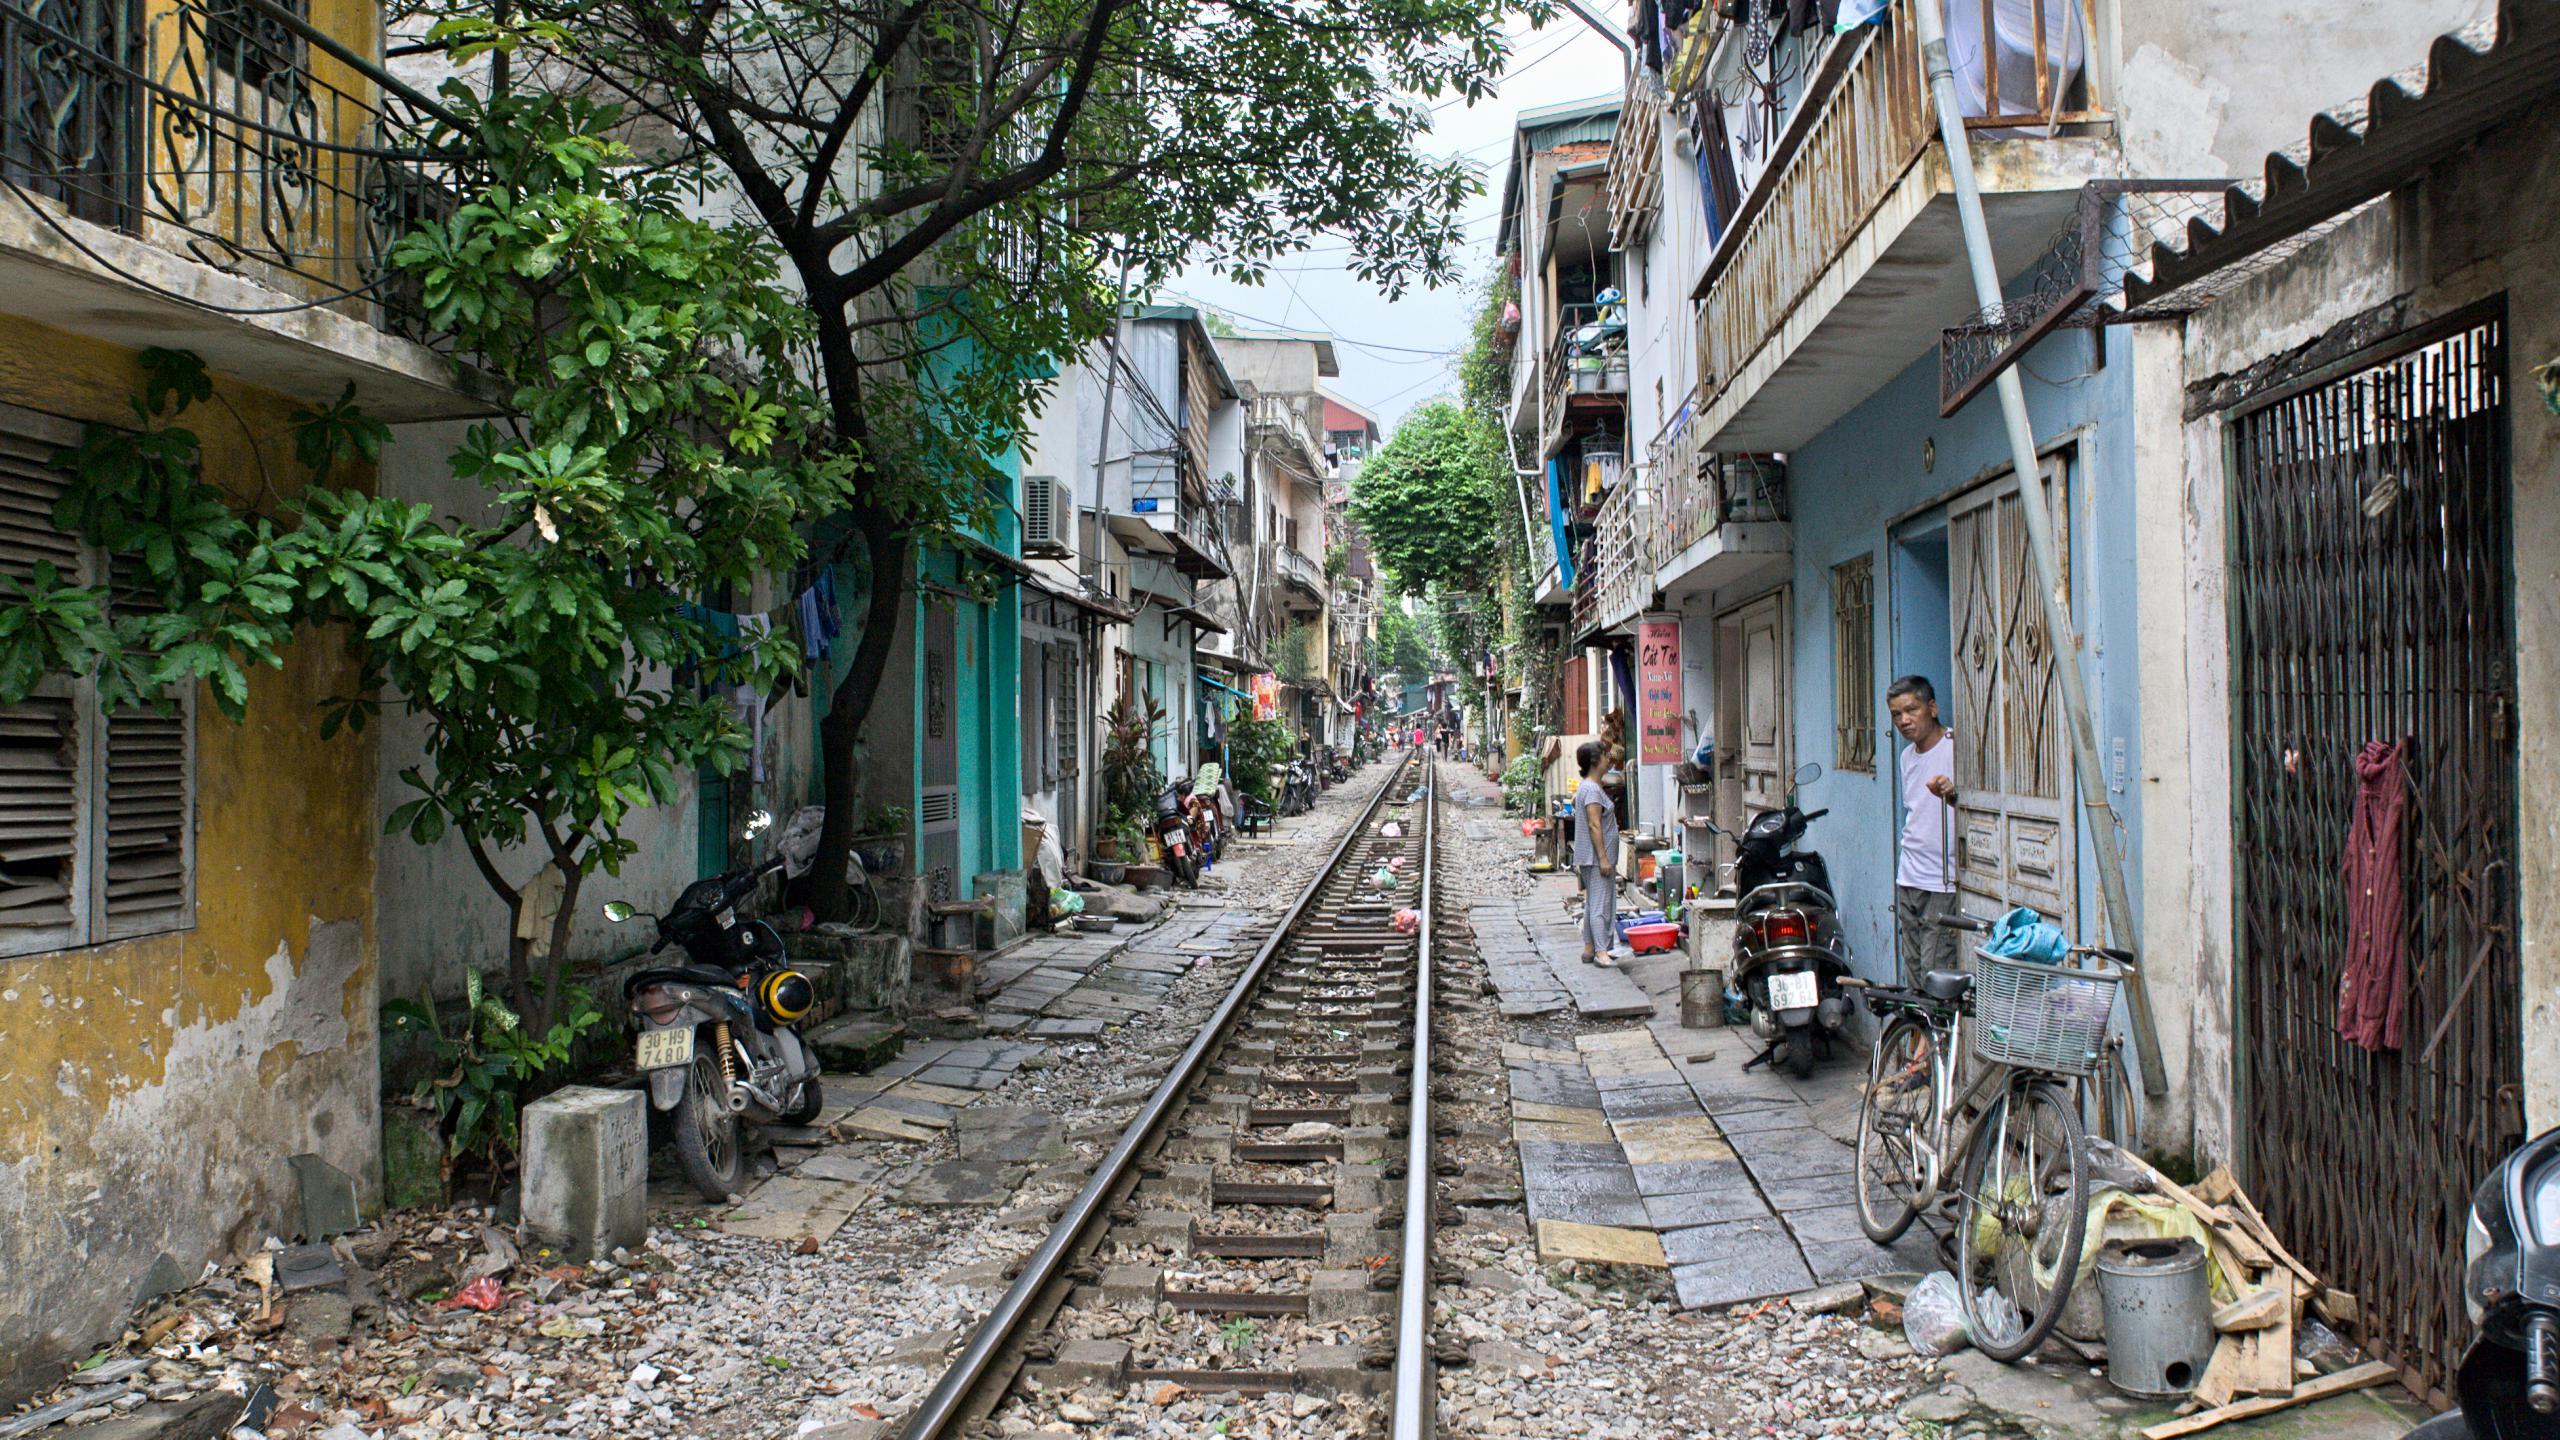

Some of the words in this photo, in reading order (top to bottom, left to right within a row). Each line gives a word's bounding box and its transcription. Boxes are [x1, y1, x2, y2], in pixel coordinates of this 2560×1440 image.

[1643, 643, 1658, 667] Cắt
[1660, 645, 1677, 667] Tóc
[645, 1029, 685, 1049] 30-H9
[644, 1046, 684, 1067] 7480
